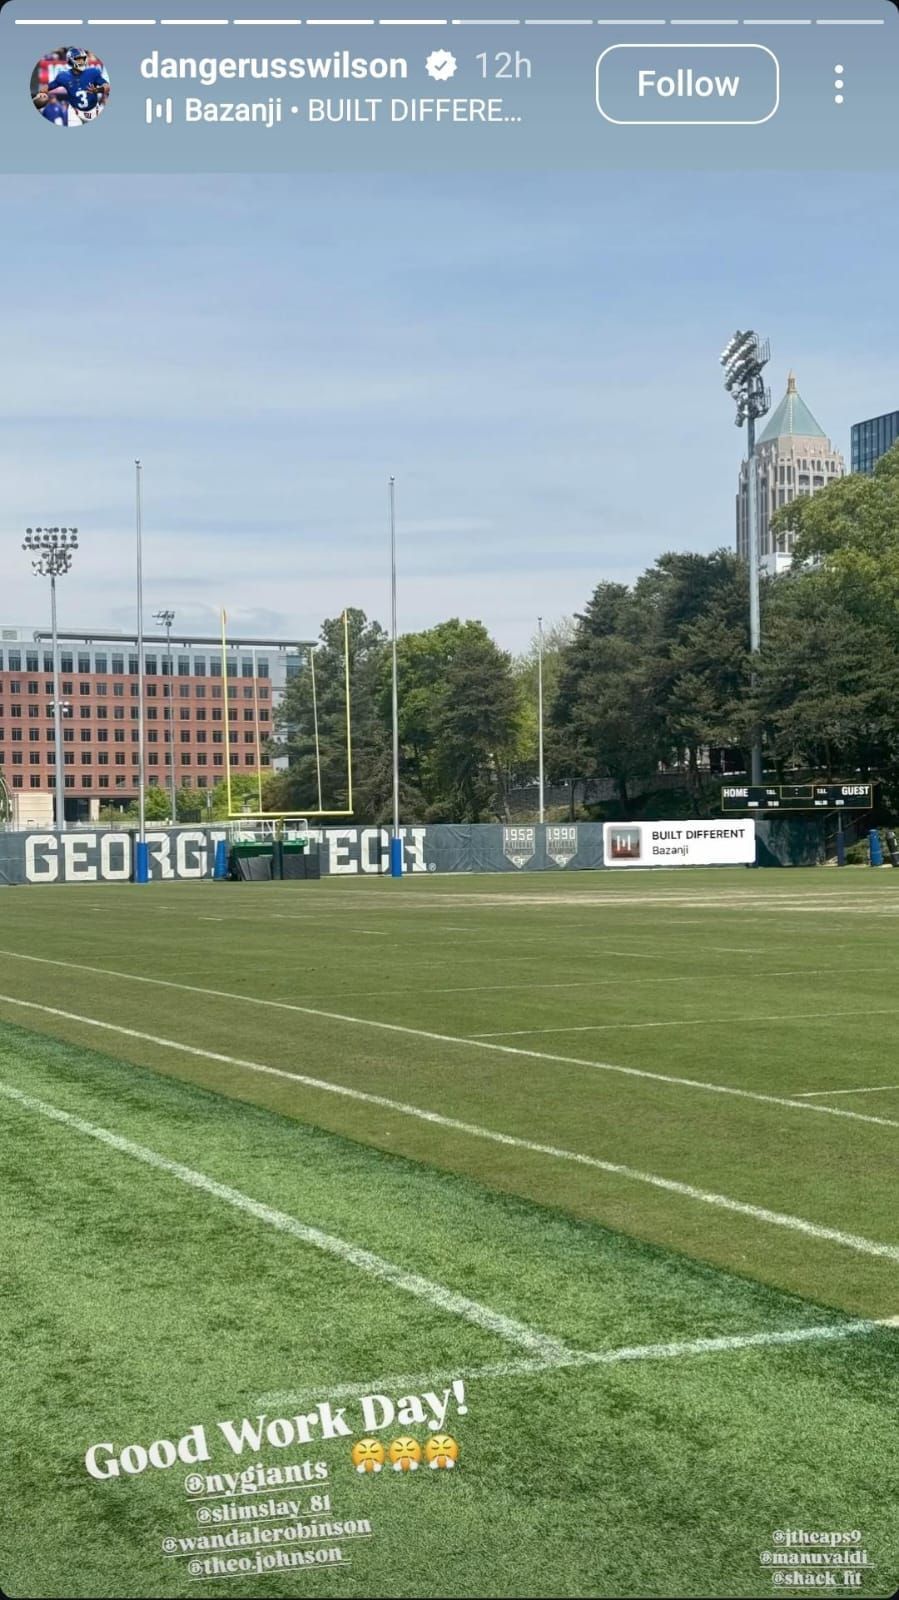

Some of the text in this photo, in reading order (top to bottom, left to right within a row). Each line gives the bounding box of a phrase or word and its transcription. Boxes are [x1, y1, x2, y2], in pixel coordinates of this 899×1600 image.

[76, 90, 88, 108] 3
[723, 786, 869, 798] HOME GUEST
[505, 829, 533, 840] 1952
[548, 828, 575, 840] 1990
